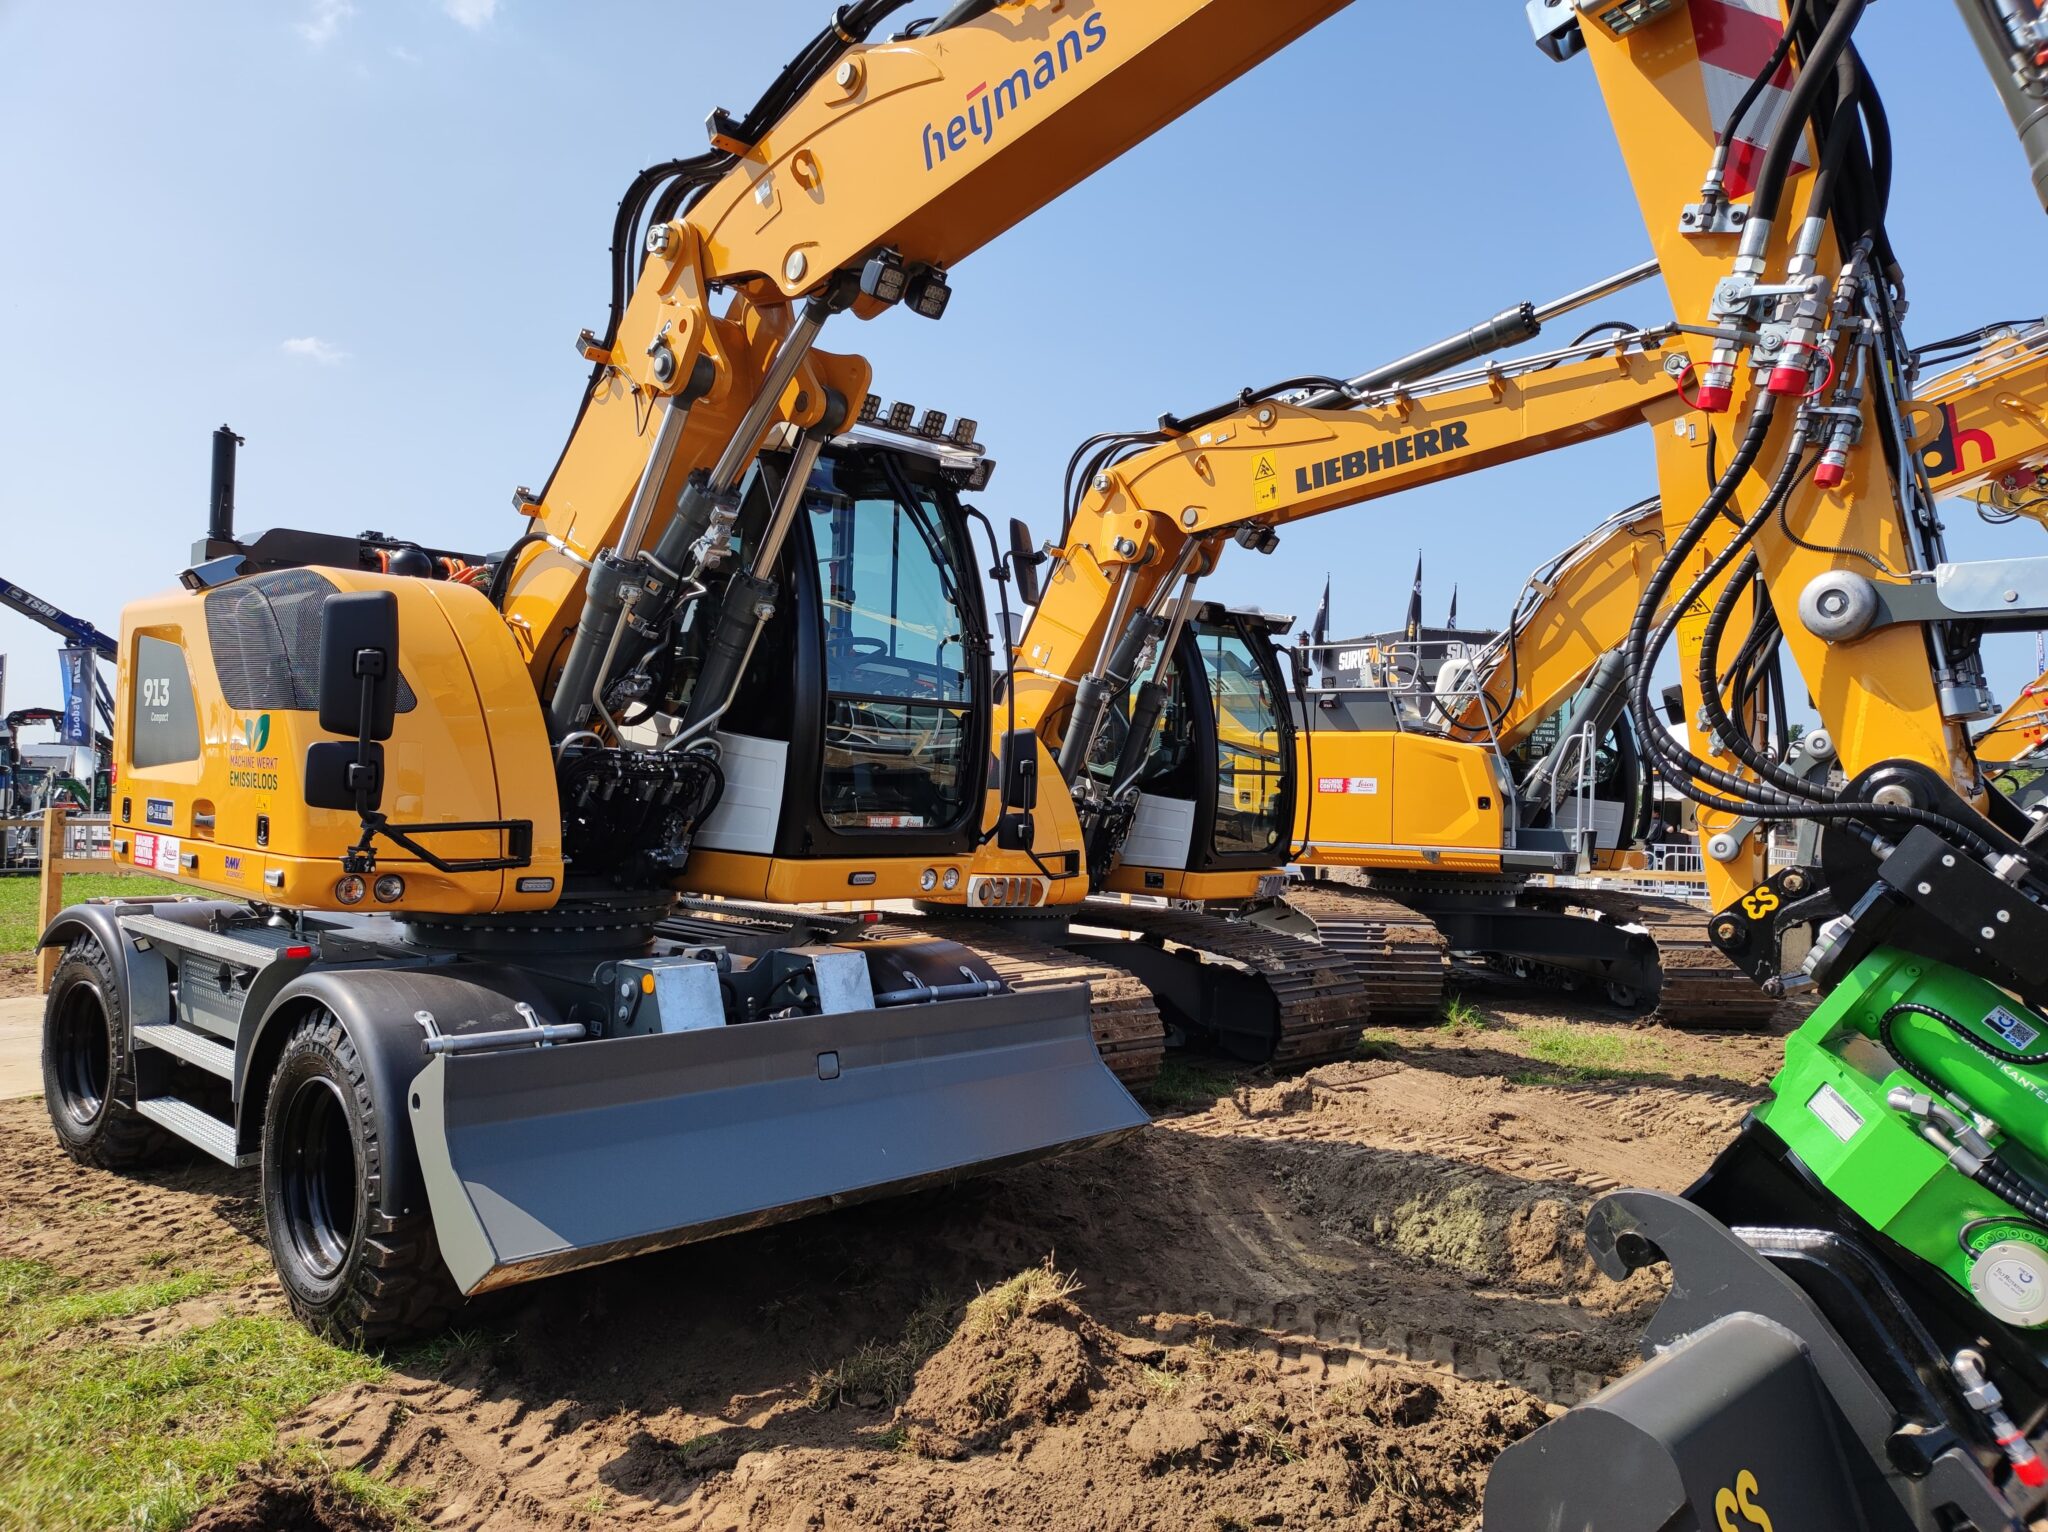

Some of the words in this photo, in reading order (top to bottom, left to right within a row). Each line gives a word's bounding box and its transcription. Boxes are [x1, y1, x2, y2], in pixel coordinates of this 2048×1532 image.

[922, 11, 1107, 171] heijmans
[1295, 420, 1470, 494] LIEBHERR
[143, 678, 170, 707] 913
[151, 712, 169, 724] Compact
[230, 755, 255, 769] MACHINE
[257, 757, 278, 770] WERKT
[230, 770, 278, 791] EMISSIELOOS
